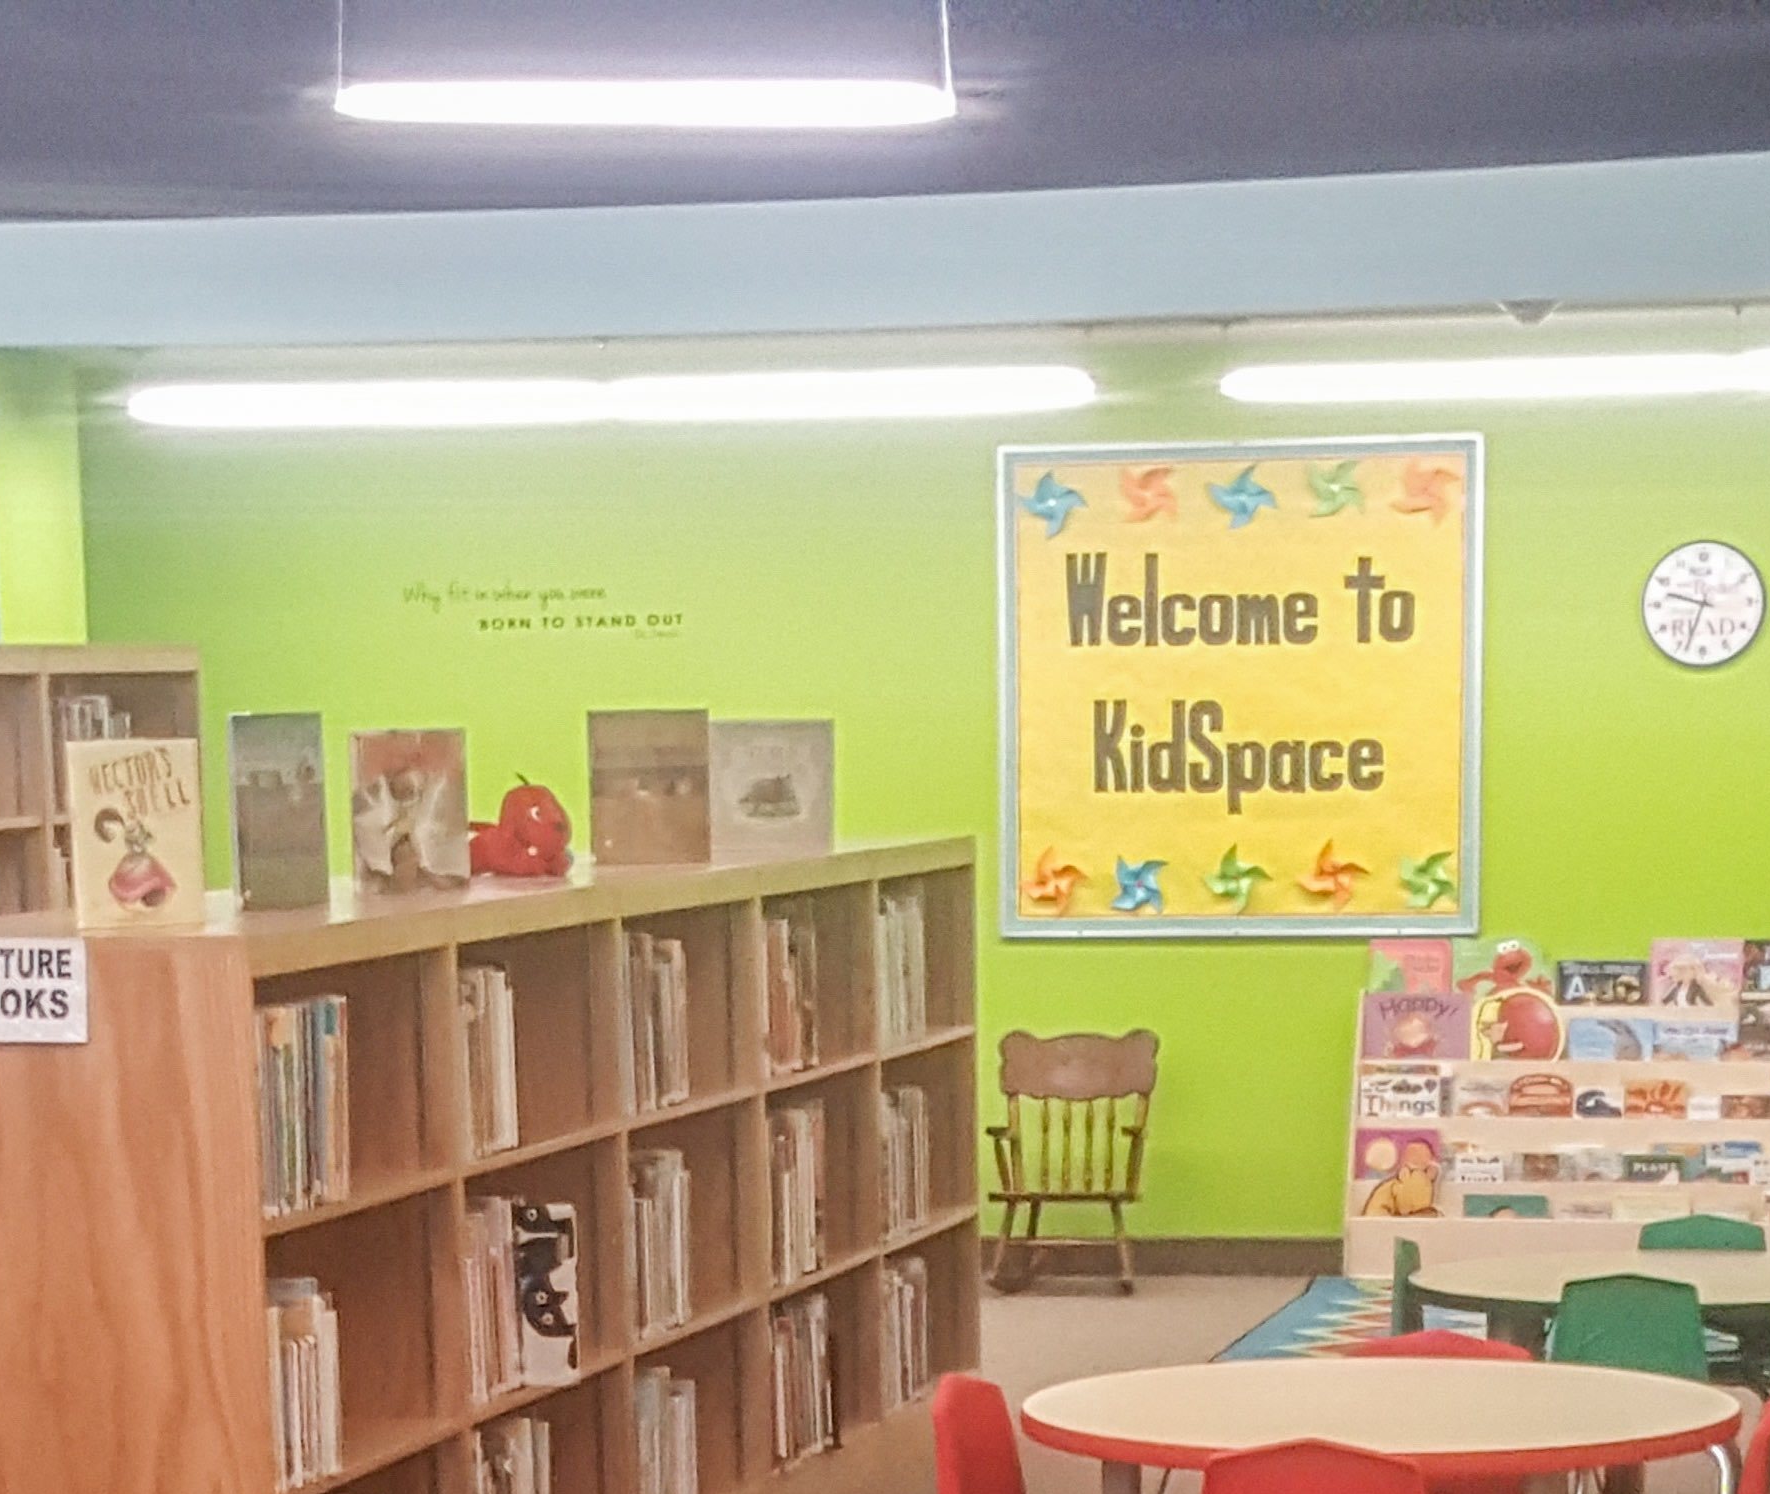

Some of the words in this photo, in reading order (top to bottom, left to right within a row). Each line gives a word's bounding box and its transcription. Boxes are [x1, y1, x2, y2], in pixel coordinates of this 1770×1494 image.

[478, 618, 532, 631] BORN
[542, 616, 565, 629] TO
[574, 614, 637, 629] STAND
[646, 612, 682, 627] OUT
[1066, 552, 1318, 646] Welcome
[1344, 556, 1415, 643] to
[1093, 698, 1385, 816] KidSpace
